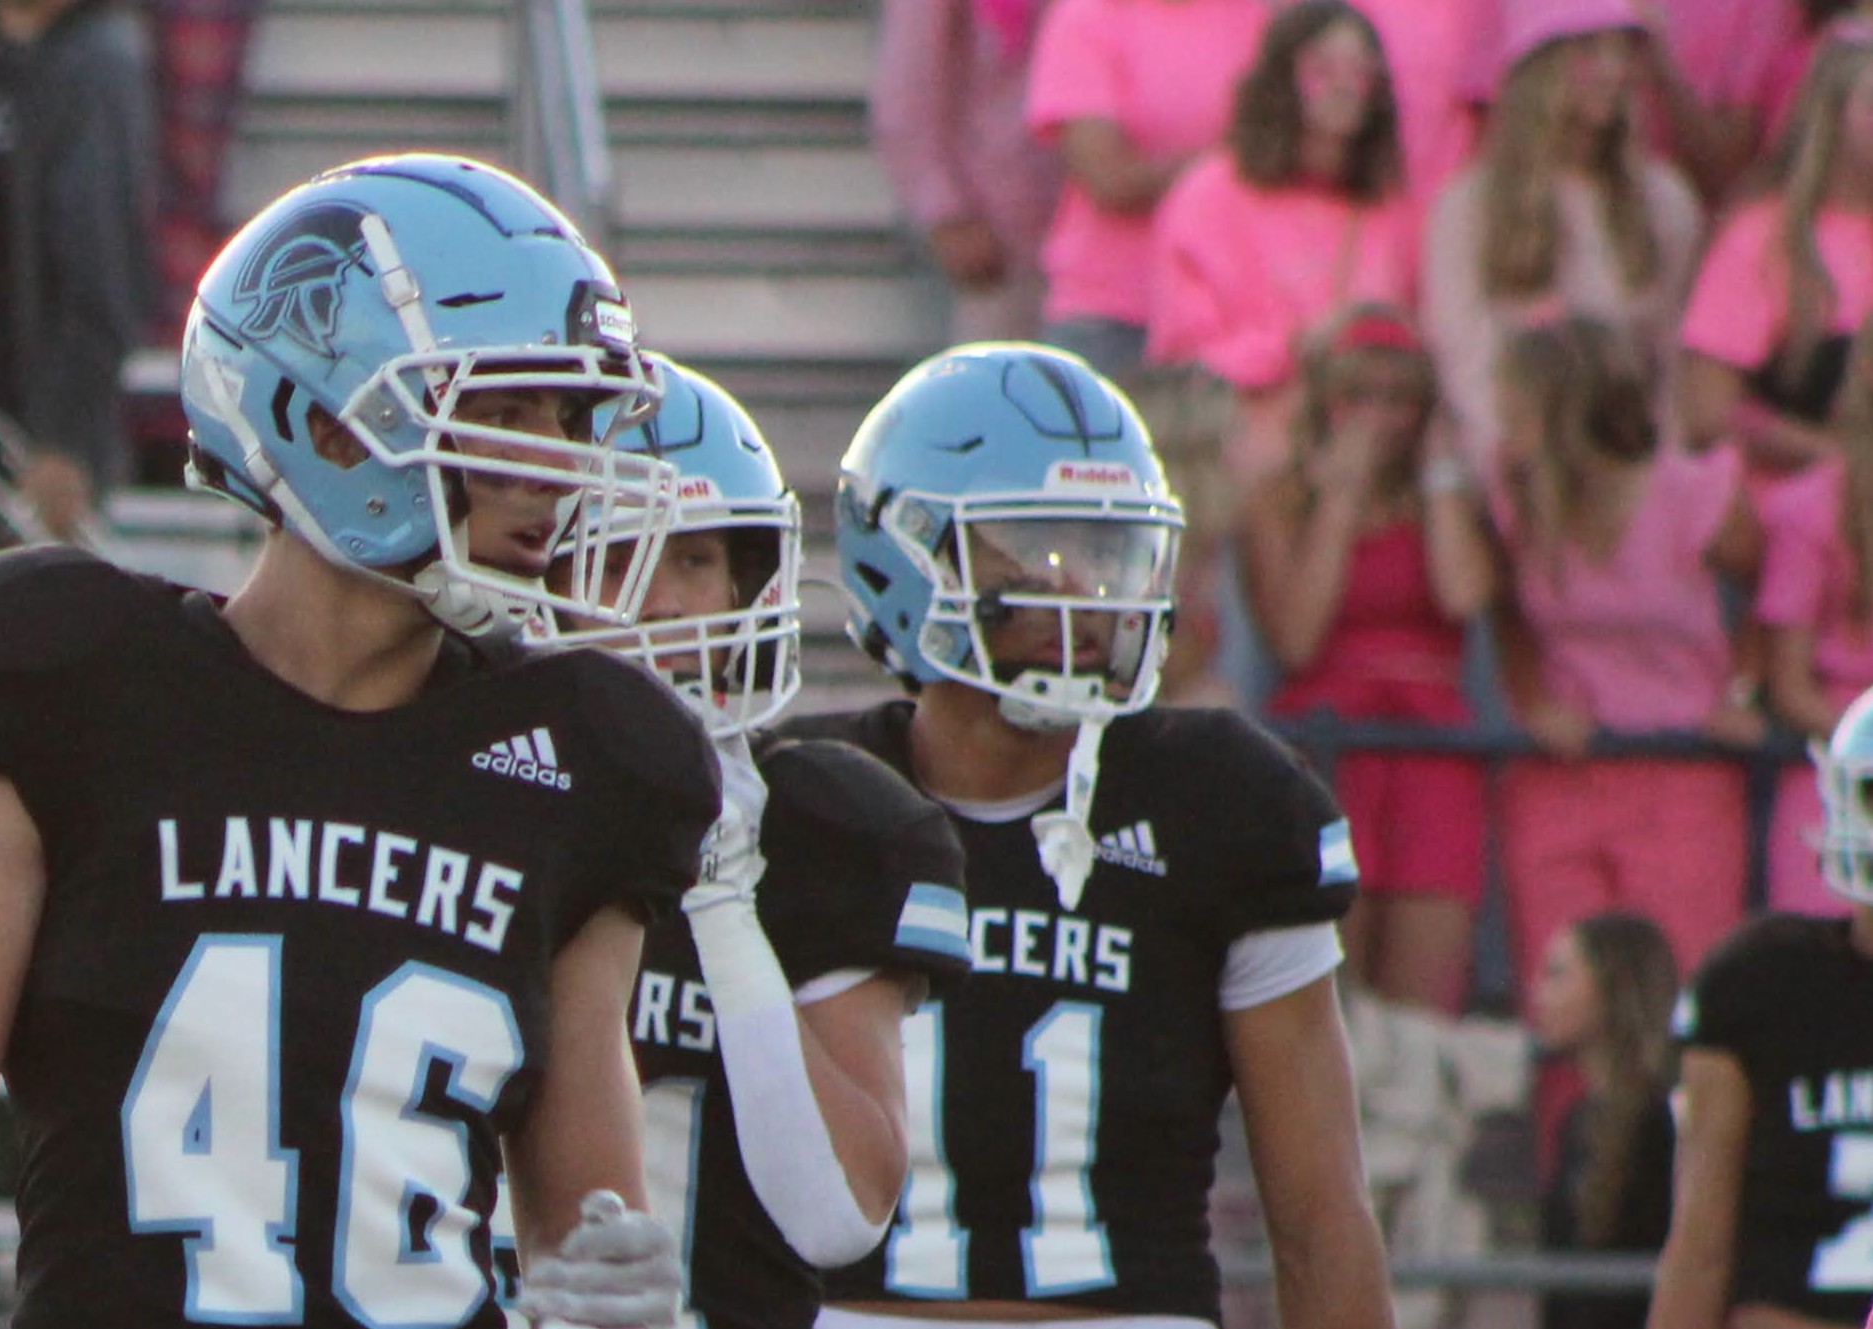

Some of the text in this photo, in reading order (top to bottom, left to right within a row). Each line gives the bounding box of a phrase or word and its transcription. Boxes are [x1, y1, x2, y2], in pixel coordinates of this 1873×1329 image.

[471, 751, 572, 791] adidas
[158, 816, 524, 954] LANCERS
[969, 907, 1134, 993] CERS
[884, 1000, 1118, 1300] 11
